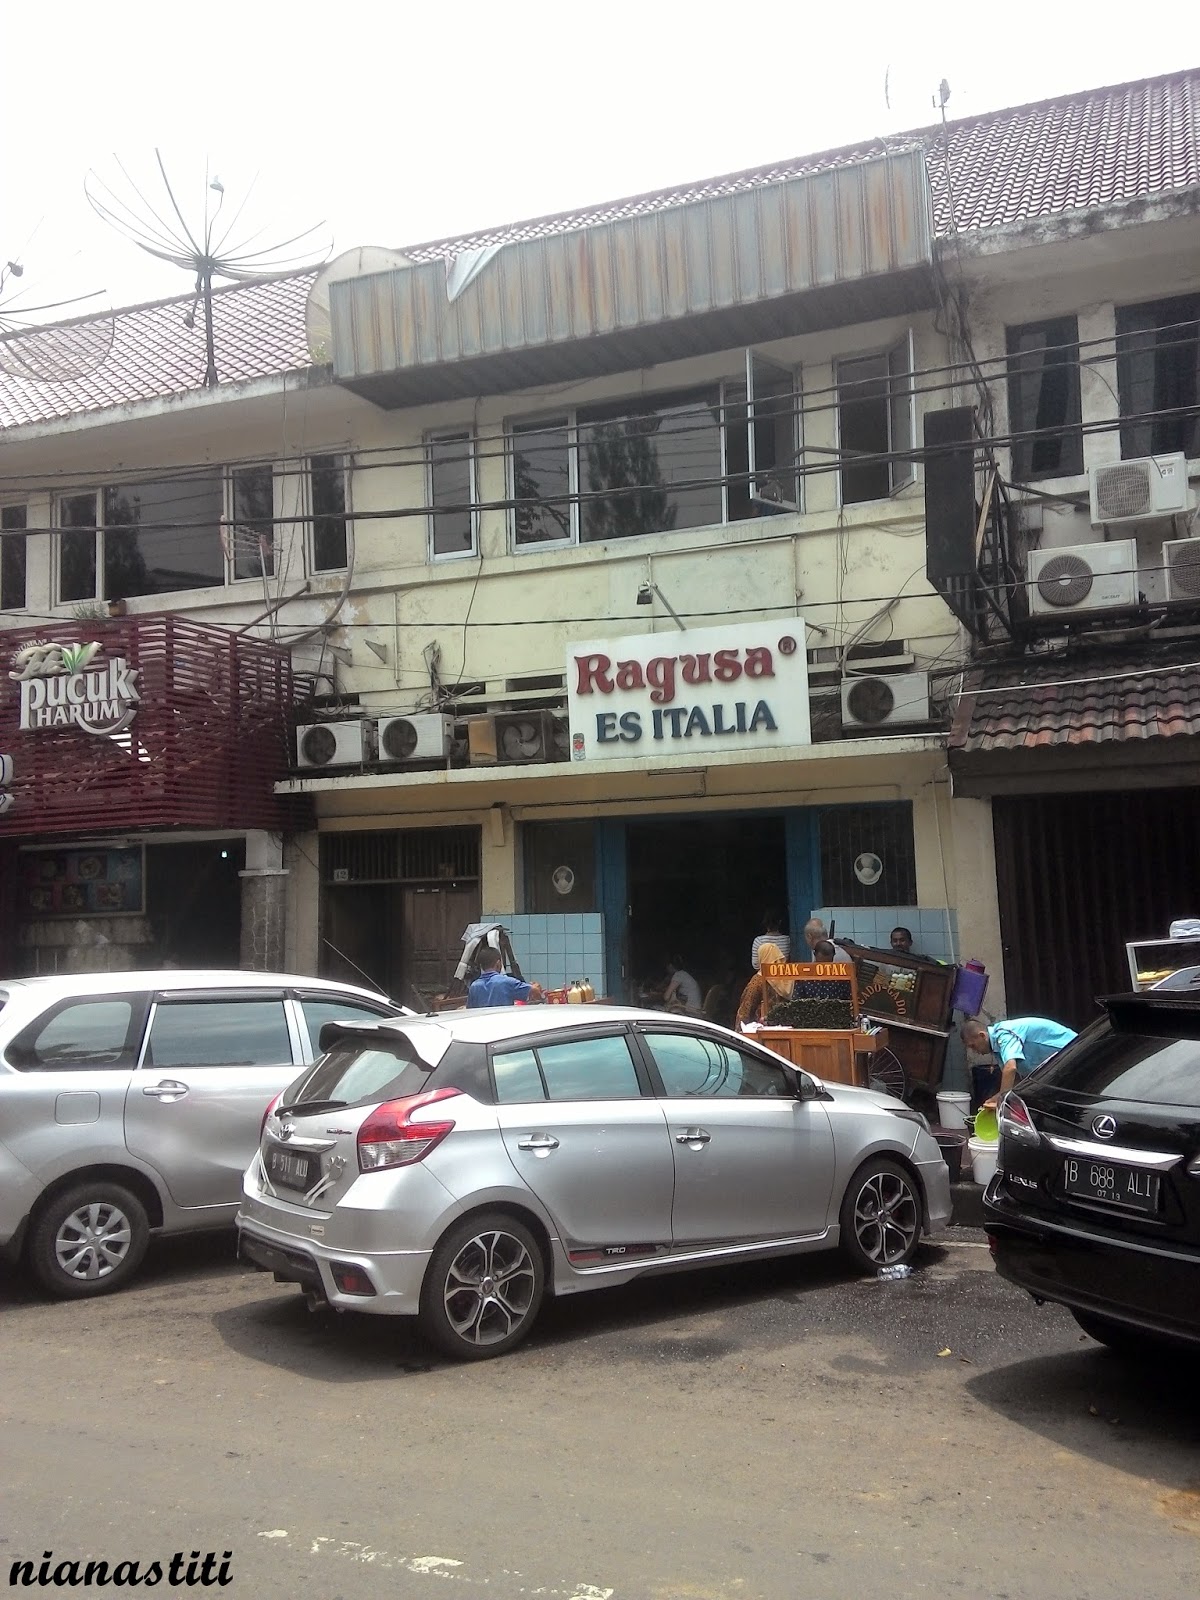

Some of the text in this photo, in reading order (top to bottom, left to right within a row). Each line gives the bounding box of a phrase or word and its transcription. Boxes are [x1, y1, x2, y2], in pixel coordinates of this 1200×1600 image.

[574, 646, 775, 703] Ragusa
[36, 699, 129, 731] HARUM
[595, 699, 778, 743] ES ITALIA
[769, 964, 799, 977] OTAK
[816, 963, 847, 976] OTAK
[1009, 1173, 1038, 1190] LEXUS
[1069, 1160, 1151, 1197] B 688 ALI
